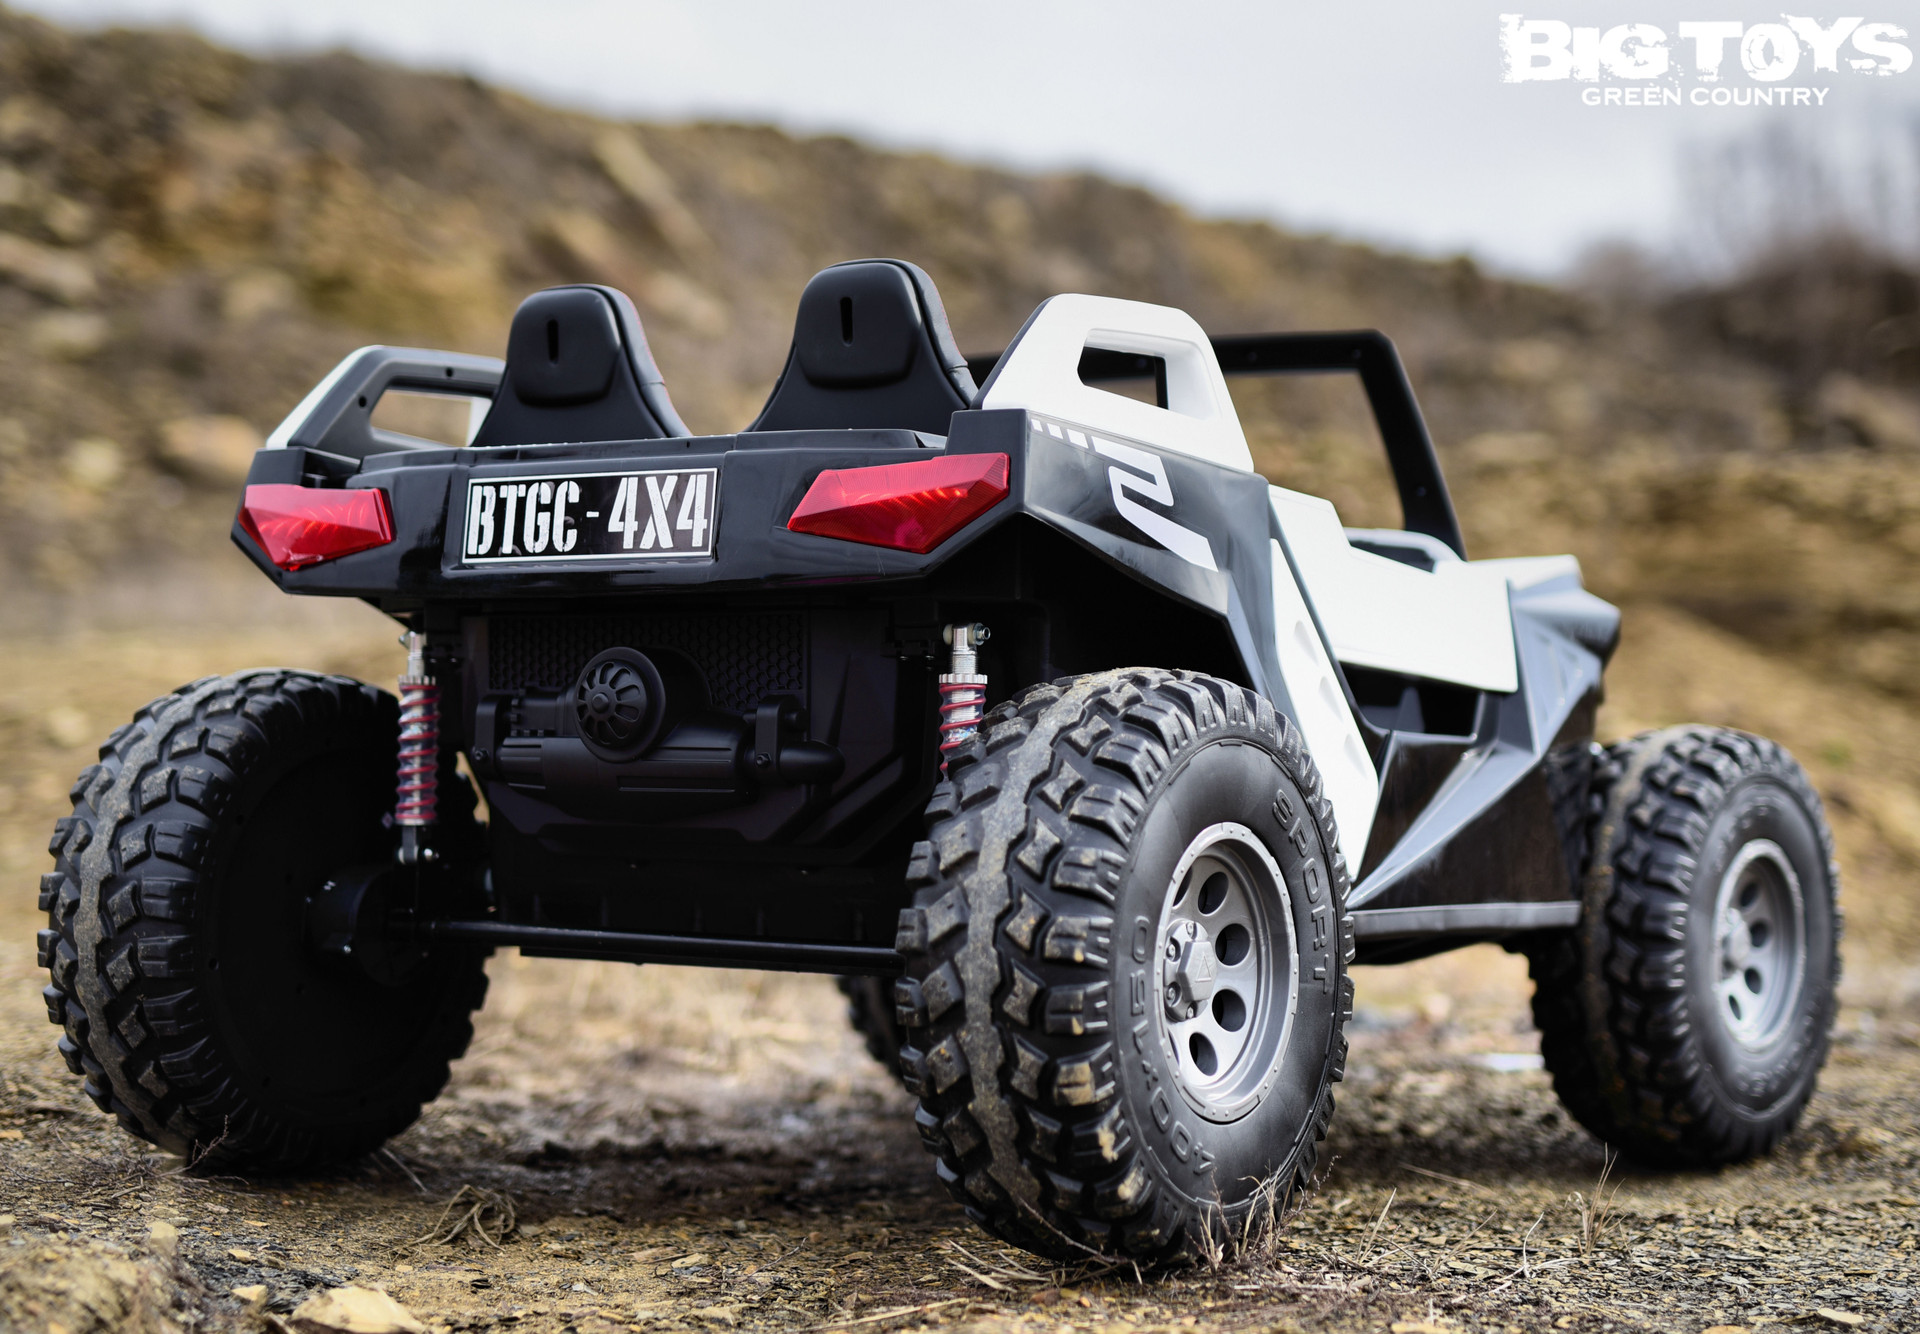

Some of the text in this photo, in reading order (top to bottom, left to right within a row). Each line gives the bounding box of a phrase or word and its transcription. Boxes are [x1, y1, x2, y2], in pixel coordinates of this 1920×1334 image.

[467, 480, 580, 555] BTGC
[608, 474, 708, 550] 4X4
[1272, 789, 1330, 994] SPORT
